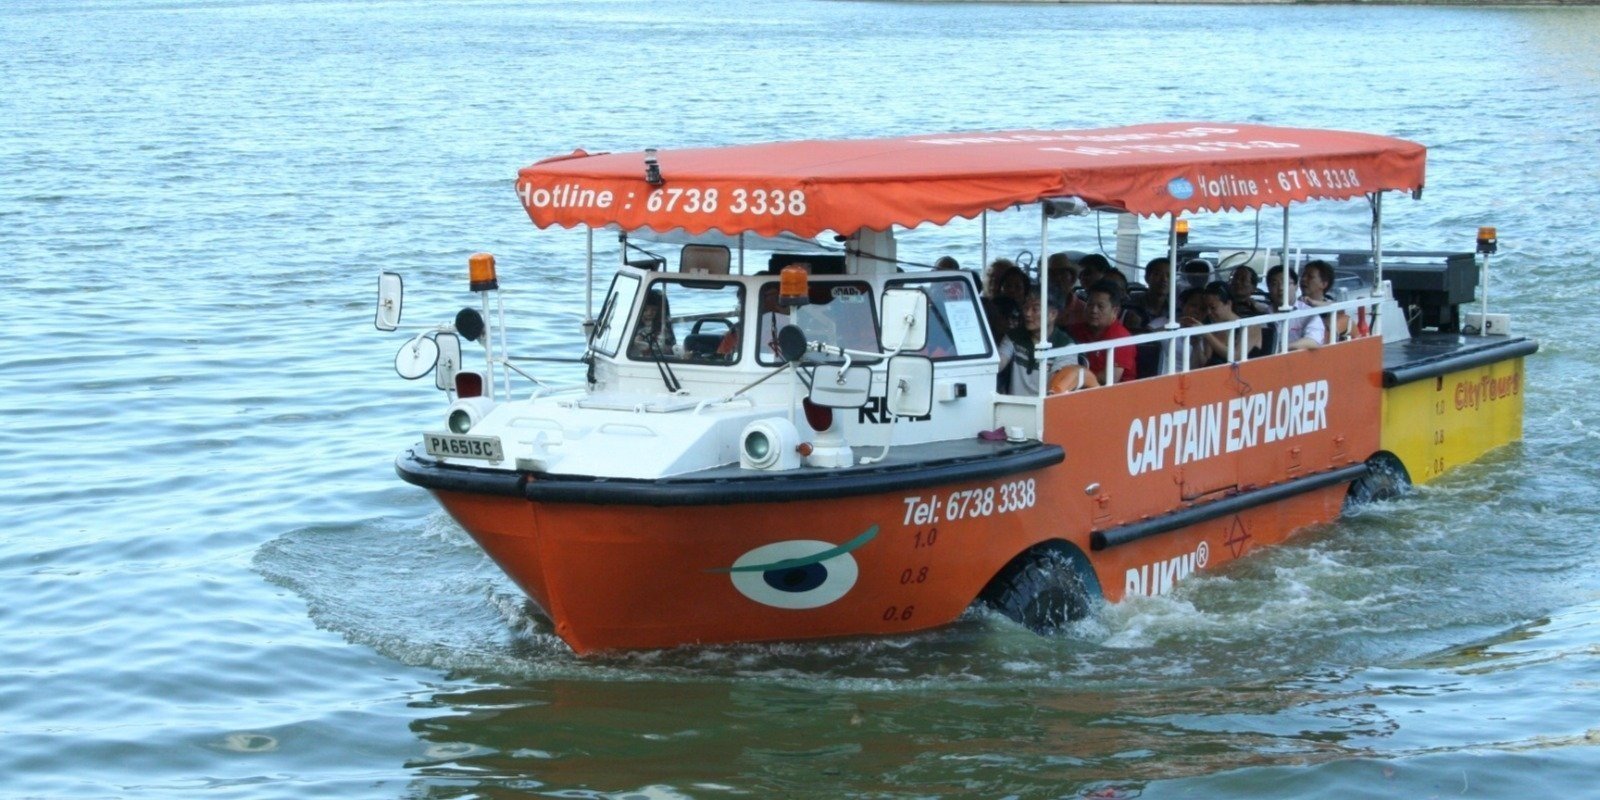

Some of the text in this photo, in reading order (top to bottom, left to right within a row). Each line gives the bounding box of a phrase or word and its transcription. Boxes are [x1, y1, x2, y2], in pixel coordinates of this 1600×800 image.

[1198, 174, 1258, 197] Hotline
[1323, 168, 1360, 189] 3338
[515, 182, 613, 208] Hotline
[647, 188, 718, 213] 6738
[730, 188, 807, 216] 3338
[1127, 379, 1329, 476] CAPTAIN EXPLORER
[431, 437, 493, 457] PA6513C
[903, 478, 1035, 526] Tel: 6738 3338
[914, 528, 938, 549] 1.0
[900, 566, 929, 585] 0.8
[883, 605, 914, 621] 0.6
